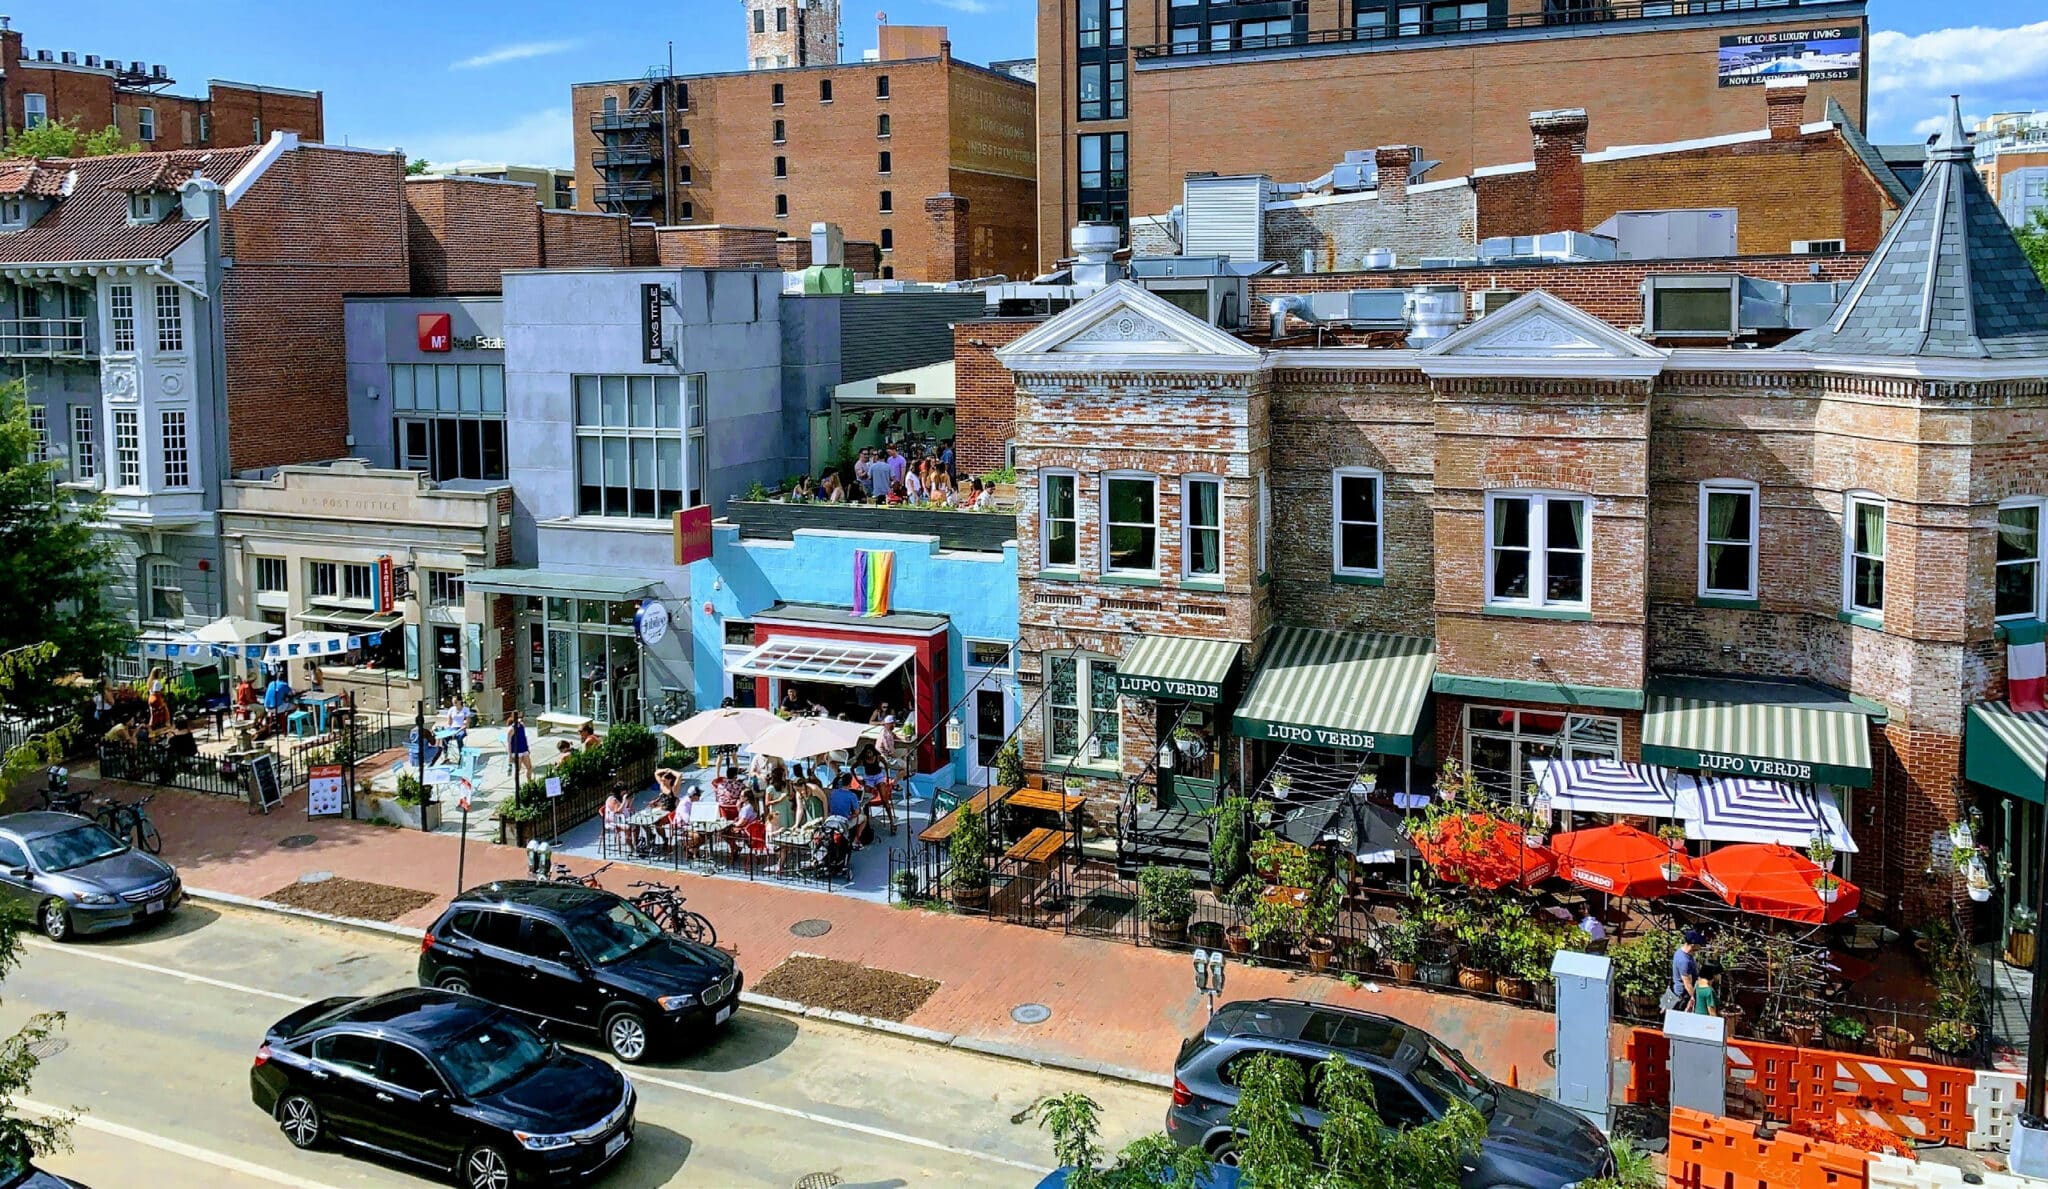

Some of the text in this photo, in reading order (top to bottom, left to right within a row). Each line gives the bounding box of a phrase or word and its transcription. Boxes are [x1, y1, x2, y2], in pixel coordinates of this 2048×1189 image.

[1737, 29, 1841, 45] THE LOUIS LUXURY LIVING
[1729, 77, 1750, 86] NOW
[650, 287, 660, 347] KVS TITLE
[322, 498, 349, 510] POST
[355, 500, 400, 512] OFFICE
[1119, 677, 1219, 699] LUPO VERDE
[1267, 724, 1375, 749] LUPO VERDE
[1698, 753, 1811, 779] LUPO VERDE
[1573, 869, 1612, 888] LUXARDO
